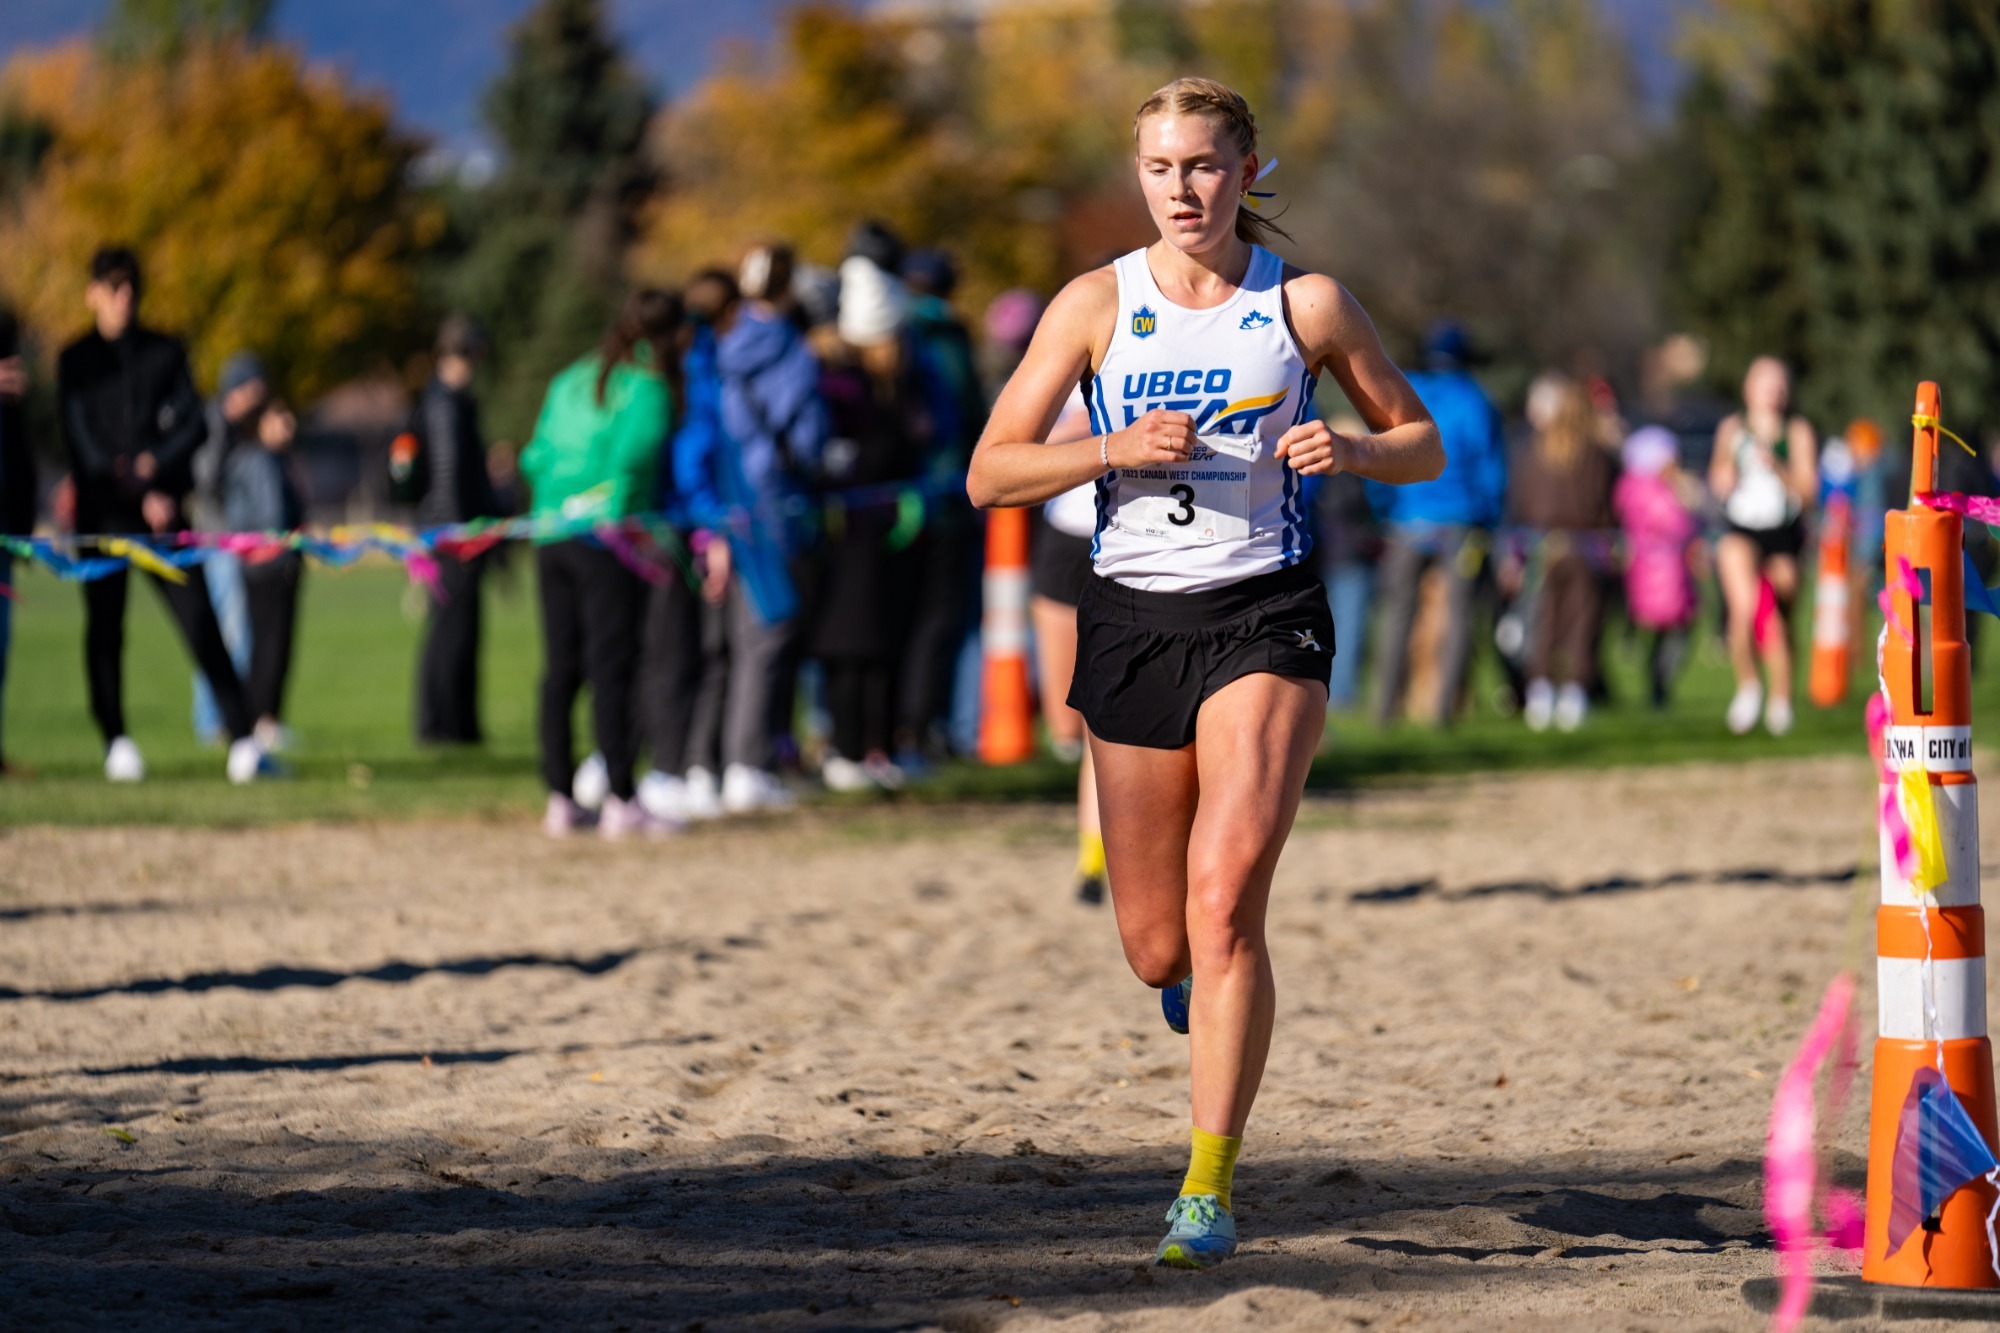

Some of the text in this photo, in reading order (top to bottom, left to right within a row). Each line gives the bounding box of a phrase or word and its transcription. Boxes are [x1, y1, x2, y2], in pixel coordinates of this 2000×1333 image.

[1133, 316, 1154, 333] CW
[1123, 369, 1232, 399] UBCO
[1121, 468, 1247, 482] 2023 CANADA WEST CHAMPIONSHIP
[1167, 483, 1196, 526] 3
[1929, 739, 1956, 759] CITY
[1959, 739, 1967, 759] of
